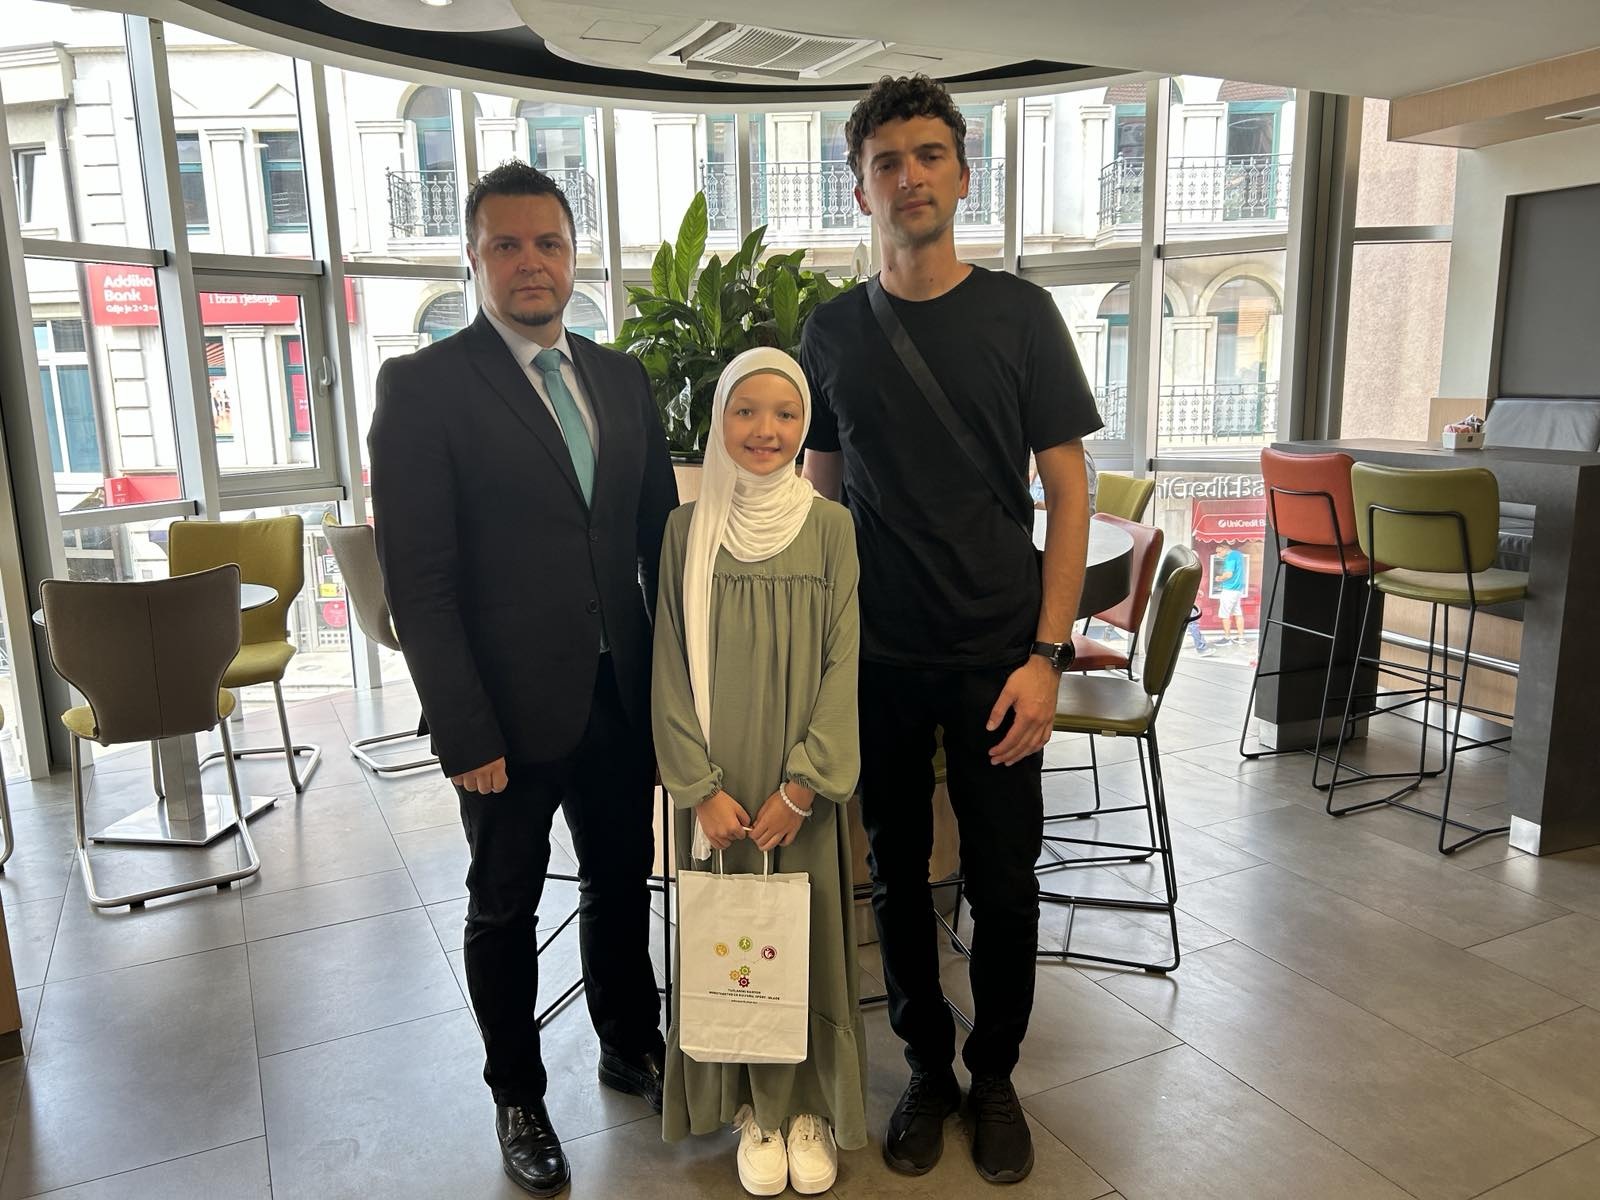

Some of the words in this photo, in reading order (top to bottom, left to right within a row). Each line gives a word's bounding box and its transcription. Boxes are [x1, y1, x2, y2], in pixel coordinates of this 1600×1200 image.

[103, 274, 153, 288] Addiko
[104, 288, 142, 301] Bank
[1156, 476, 1232, 499] niCredit
[1237, 475, 1265, 499] Ba
[1227, 519, 1259, 528] UniCredit
